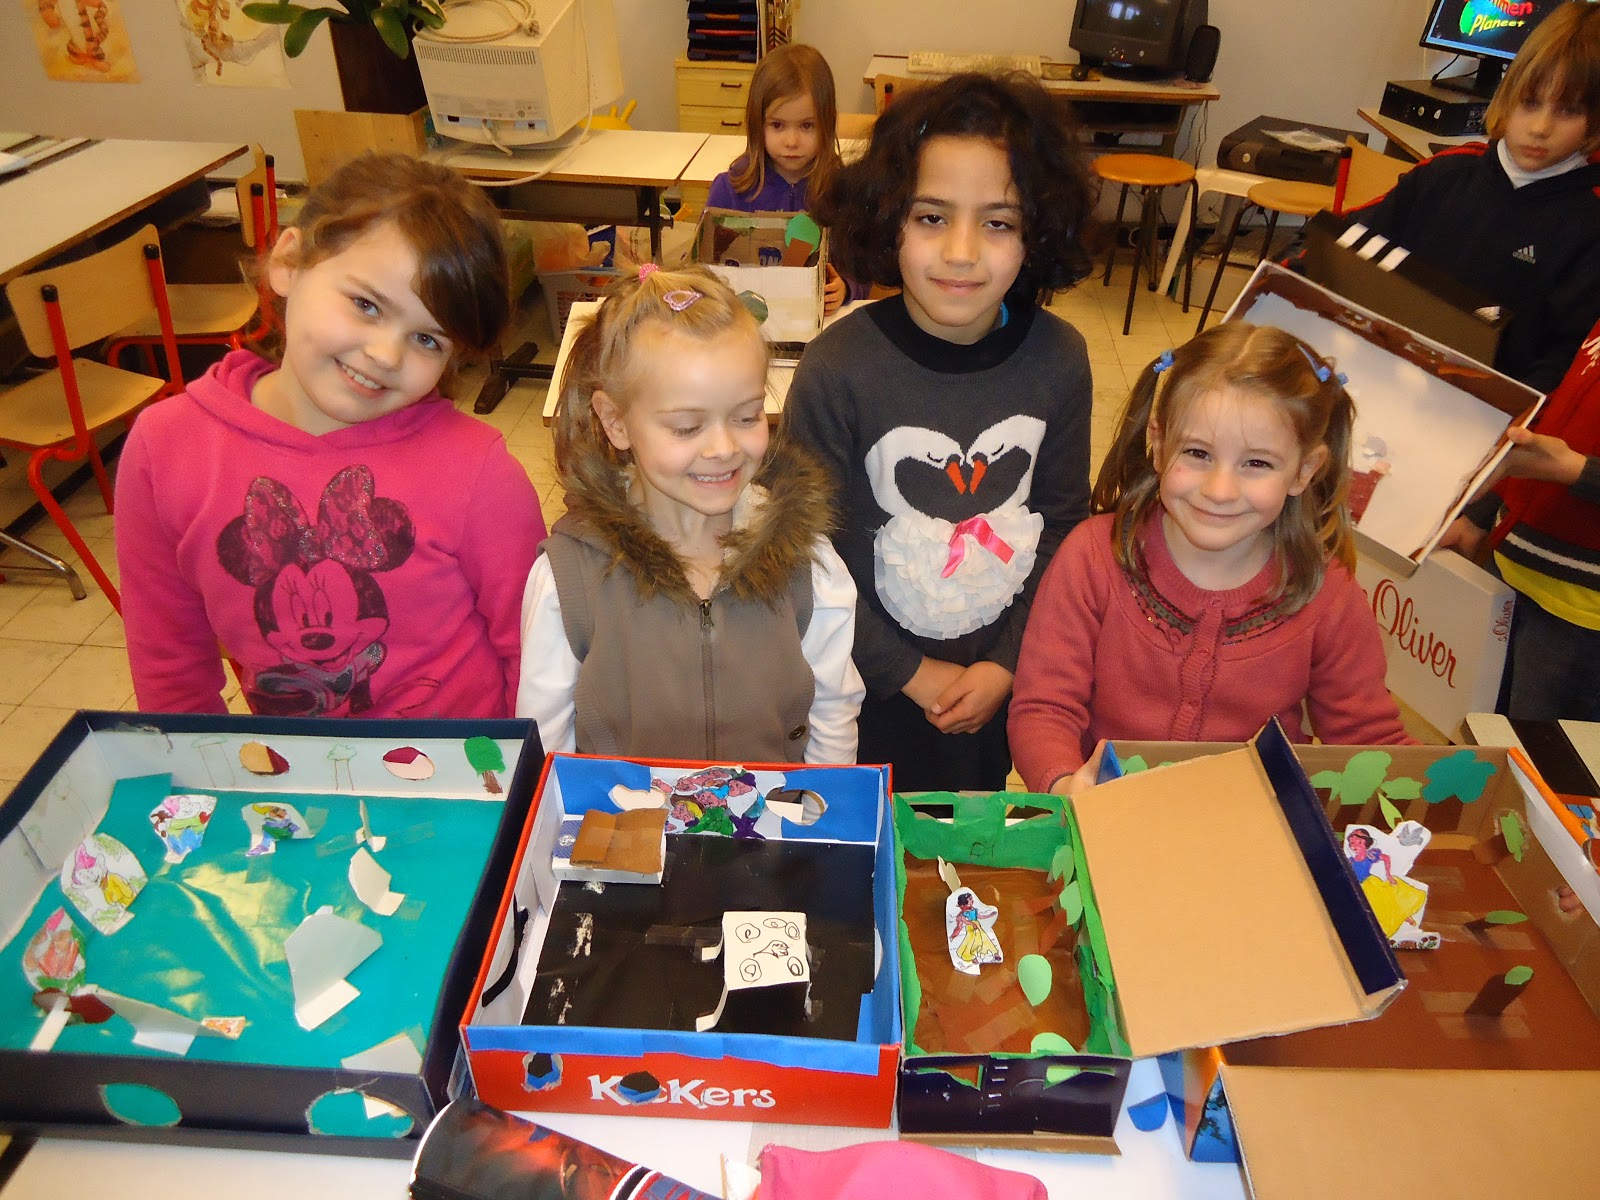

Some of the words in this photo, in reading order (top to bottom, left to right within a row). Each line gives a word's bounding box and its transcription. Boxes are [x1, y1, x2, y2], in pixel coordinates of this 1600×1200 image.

[1469, 14, 1526, 36] Planeet
[1363, 579, 1457, 689] Oliver
[587, 1074, 777, 1109] KKers
